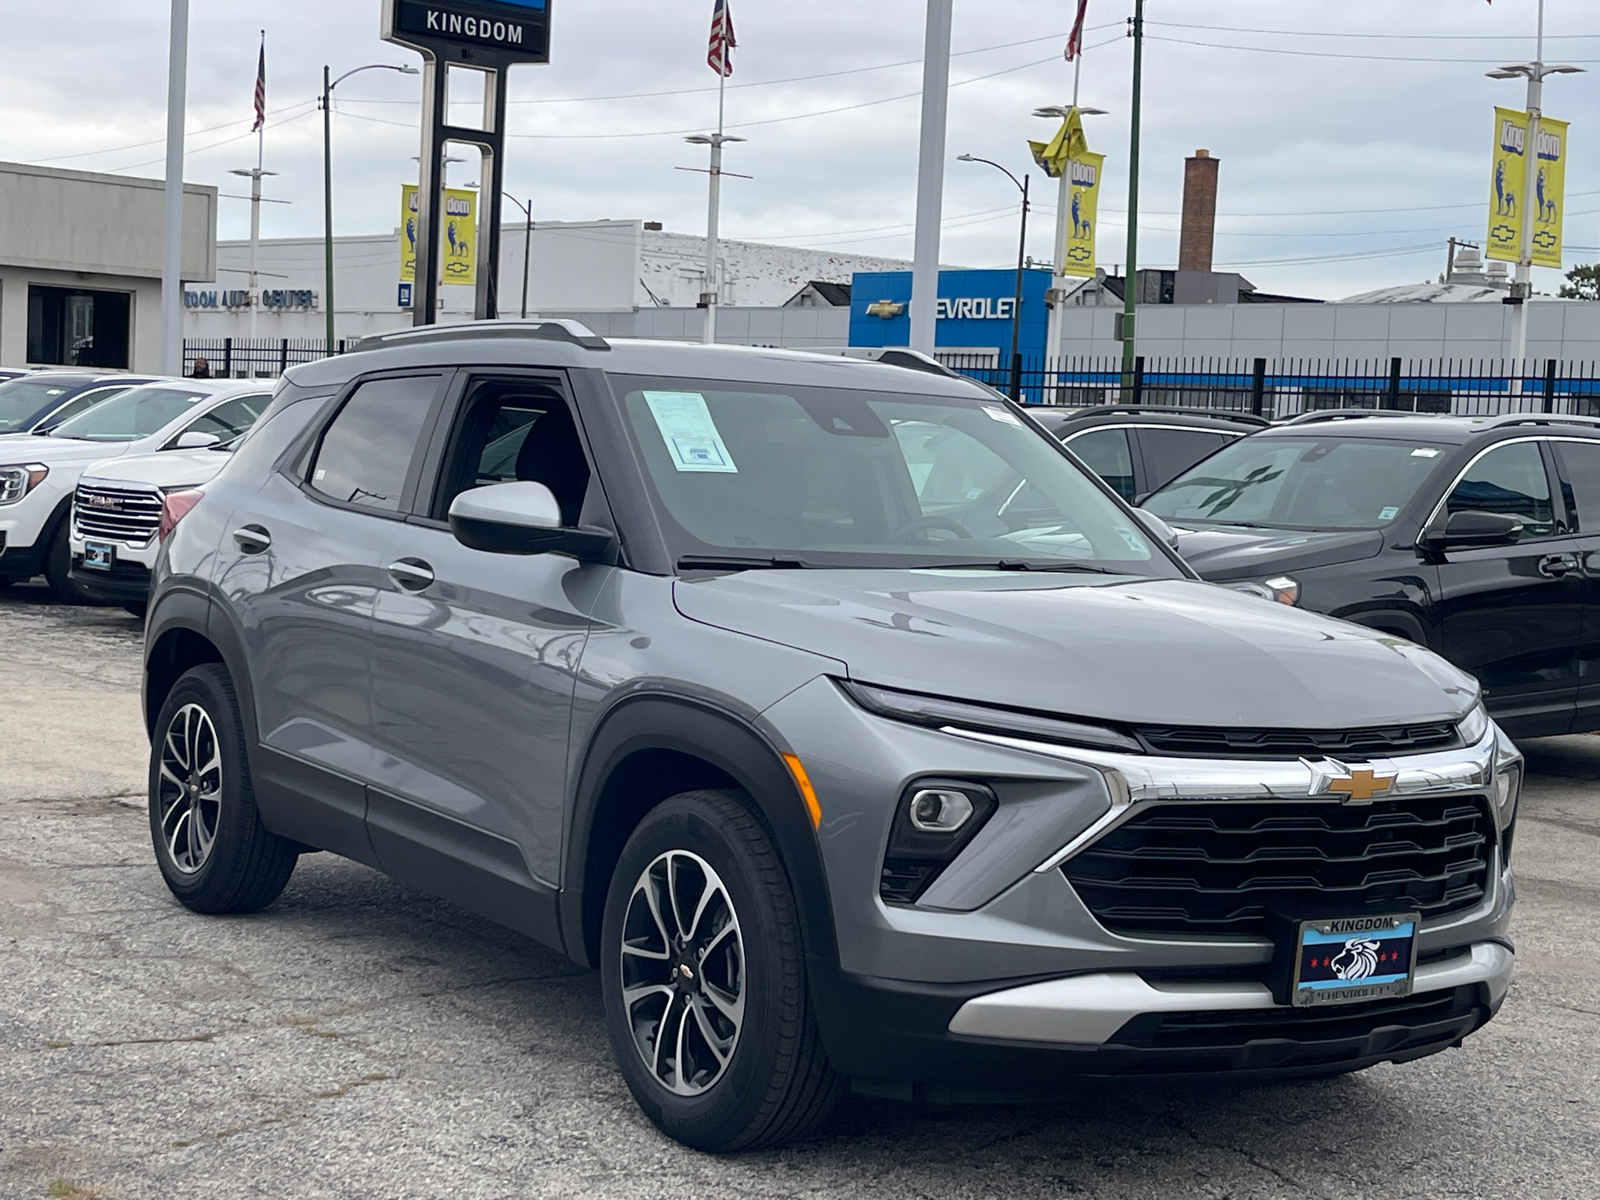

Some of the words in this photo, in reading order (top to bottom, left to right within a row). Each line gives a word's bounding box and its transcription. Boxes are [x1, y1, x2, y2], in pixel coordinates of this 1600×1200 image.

[426, 10, 523, 44] KINGDOM
[1501, 119, 1526, 154] King
[1537, 129, 1560, 157] dom
[1072, 159, 1096, 184] dom
[447, 196, 470, 214] dom
[262, 290, 315, 307] CENTER
[908, 297, 1023, 319] EVROLET
[88, 495, 124, 511] GMC
[1330, 917, 1393, 932] KINGDOM
[1321, 987, 1385, 1000] CHEVROLET
